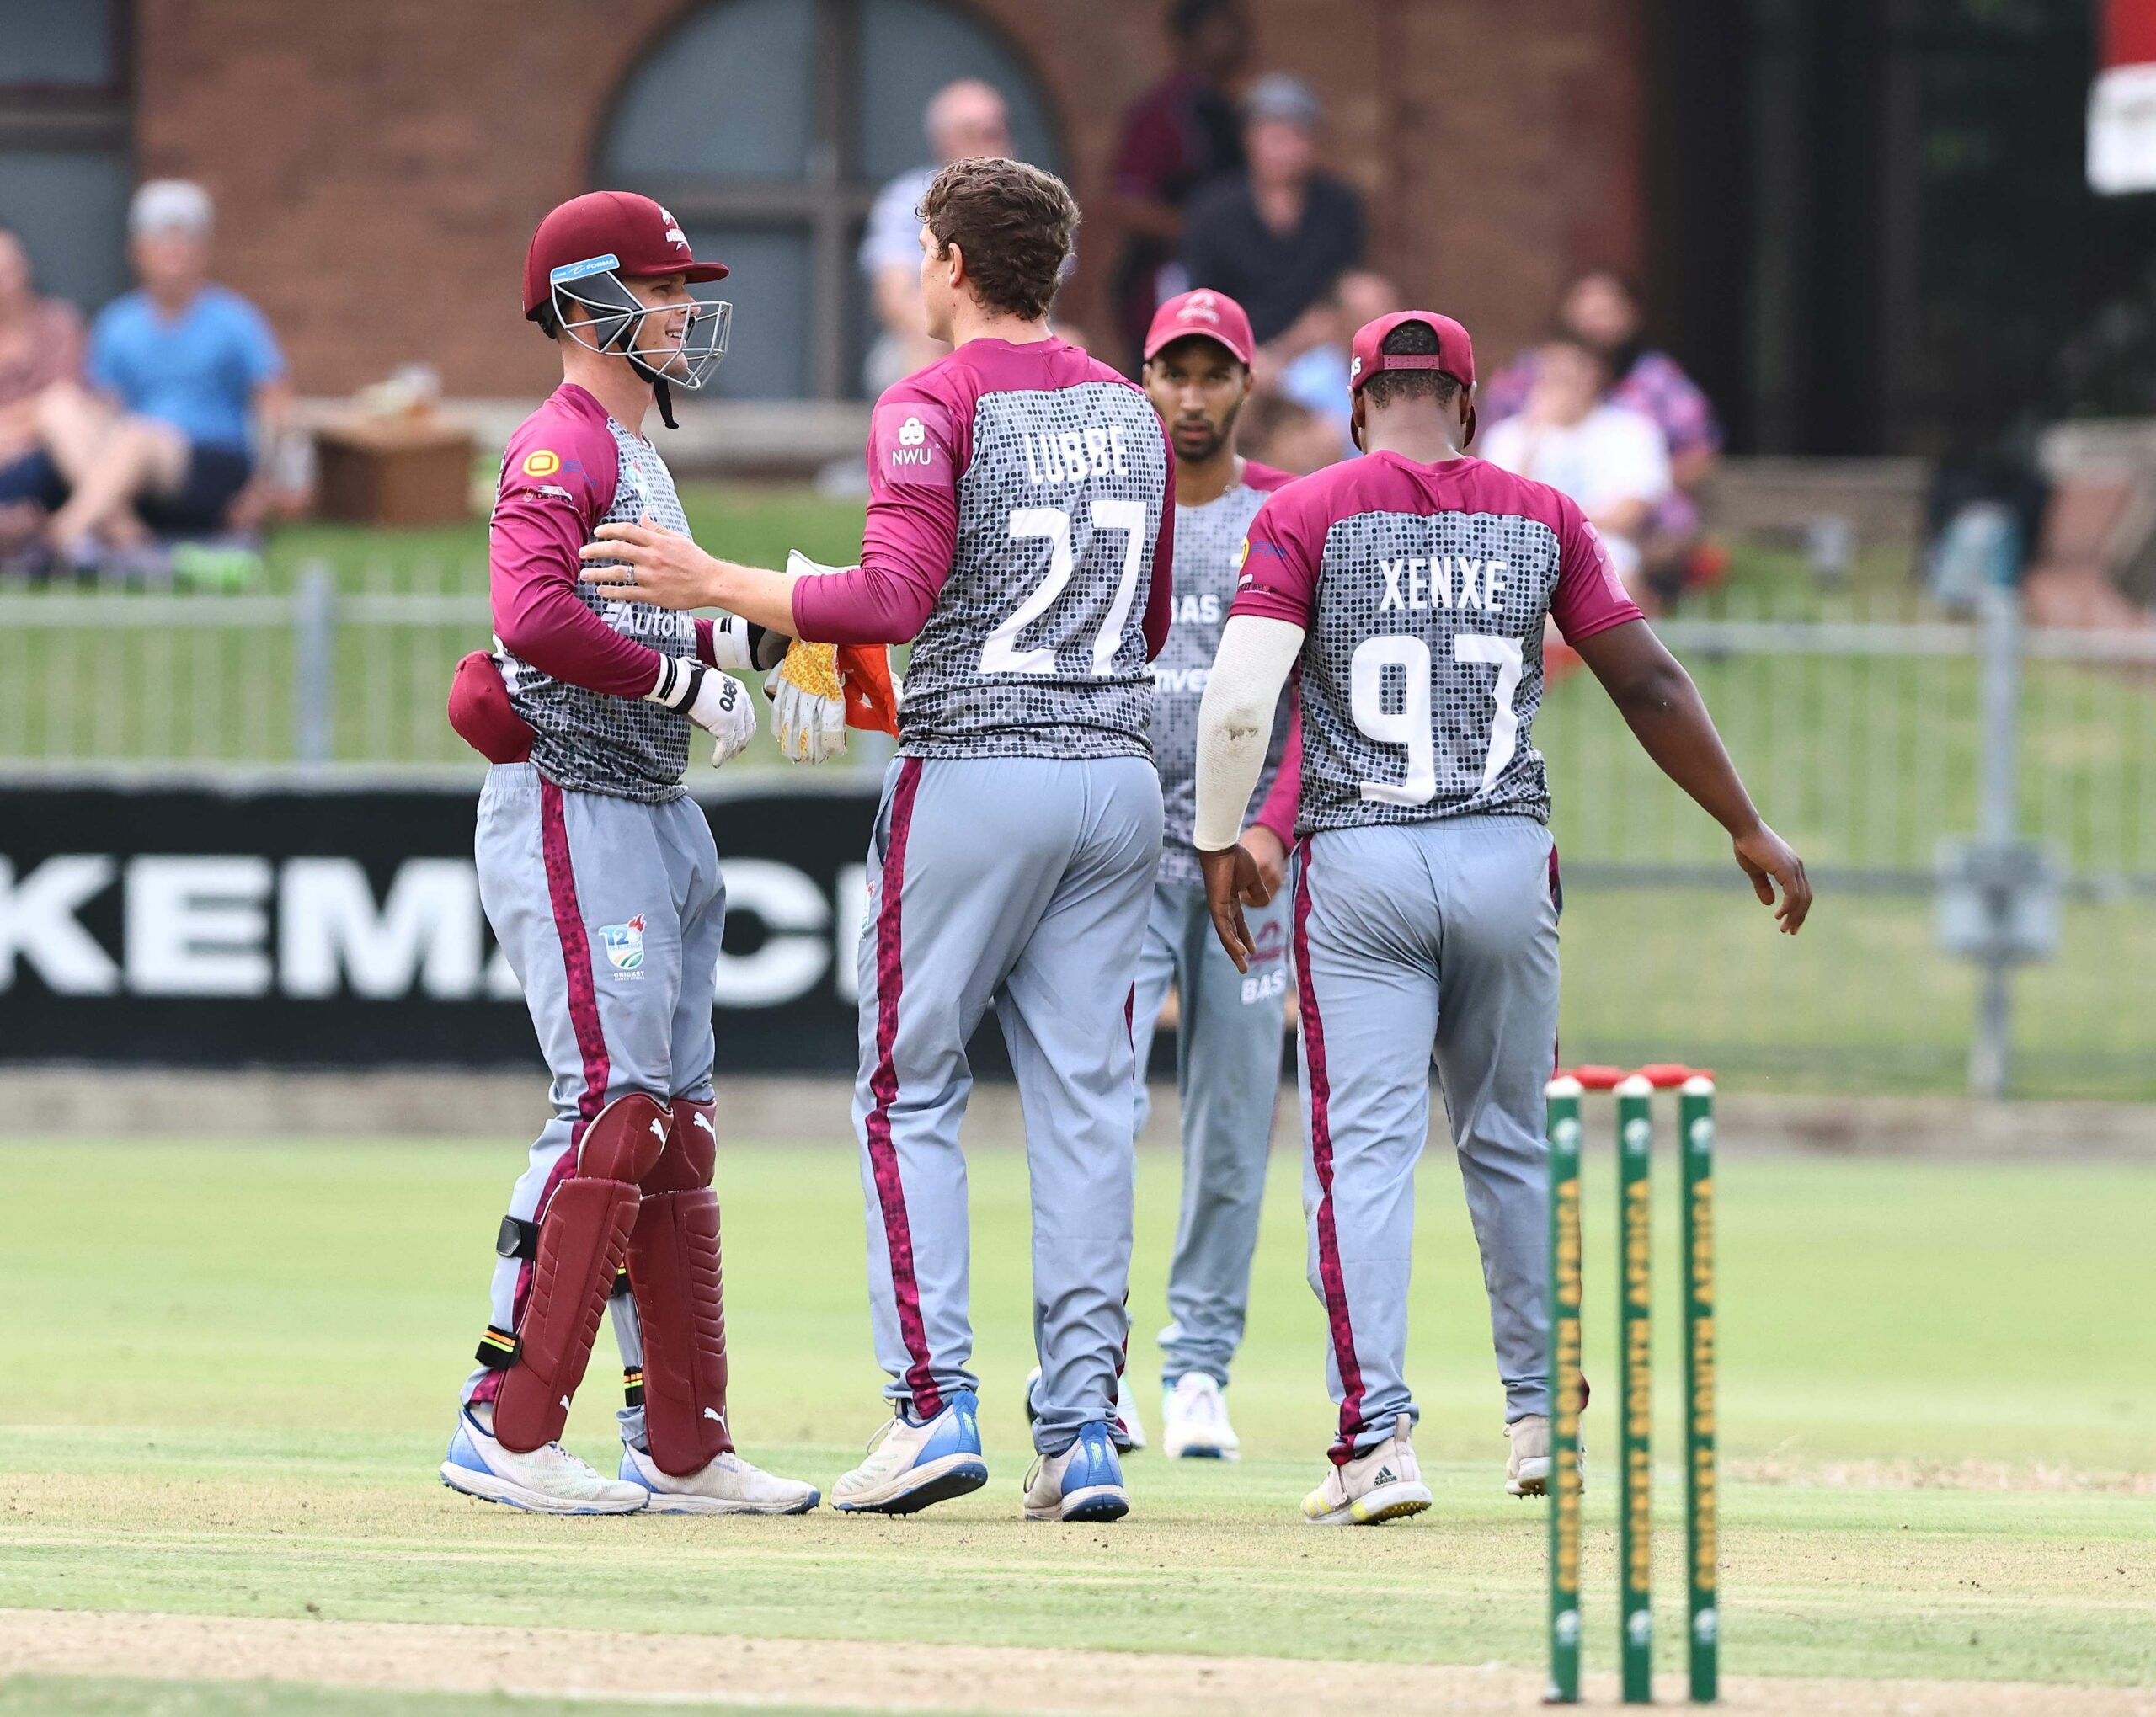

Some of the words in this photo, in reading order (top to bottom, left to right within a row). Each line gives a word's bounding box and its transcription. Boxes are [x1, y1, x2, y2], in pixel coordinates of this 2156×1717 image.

[893, 447, 931, 467] NWU
[1024, 426, 1130, 485] LUBBE
[979, 499, 1147, 675] 27
[1379, 557, 1508, 611] XENXE
[1351, 634, 1525, 807] 97
[1241, 969, 1288, 1005] BAS
